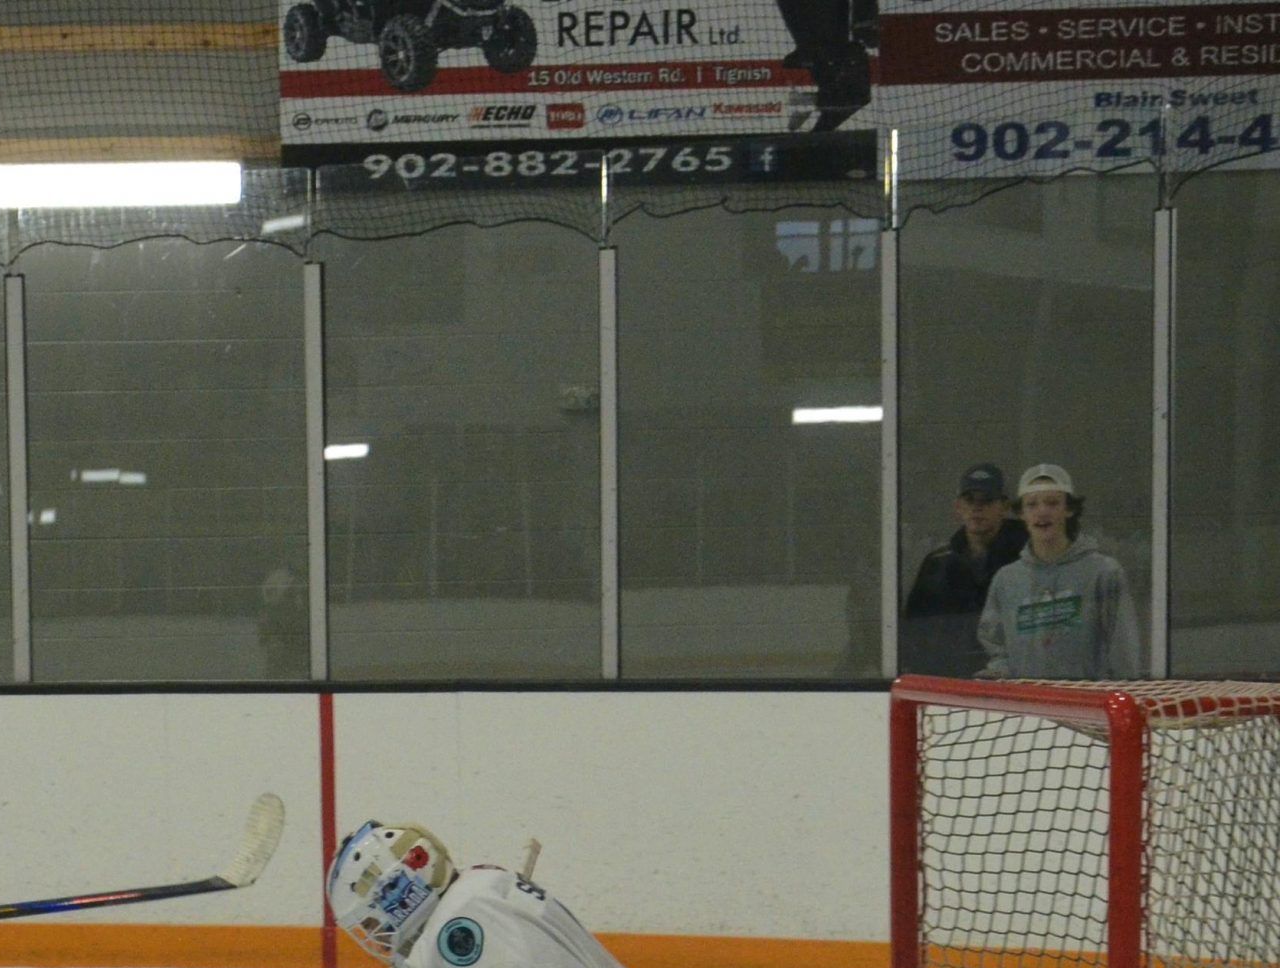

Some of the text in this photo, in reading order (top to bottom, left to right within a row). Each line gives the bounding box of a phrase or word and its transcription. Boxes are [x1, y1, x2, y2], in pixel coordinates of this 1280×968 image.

[557, 9, 699, 48] REPAIR
[935, 13, 1280, 43] SALES SERVICE INST
[961, 49, 1162, 73] COMMERCIAL
[1171, 47, 1190, 67] &
[528, 71, 550, 86] 15
[715, 66, 772, 82] Tignish
[1094, 89, 1259, 108] Blair Sweet
[482, 105, 536, 121] ECHO
[629, 106, 706, 120] LIFAN
[363, 147, 732, 179] 902-882-2765
